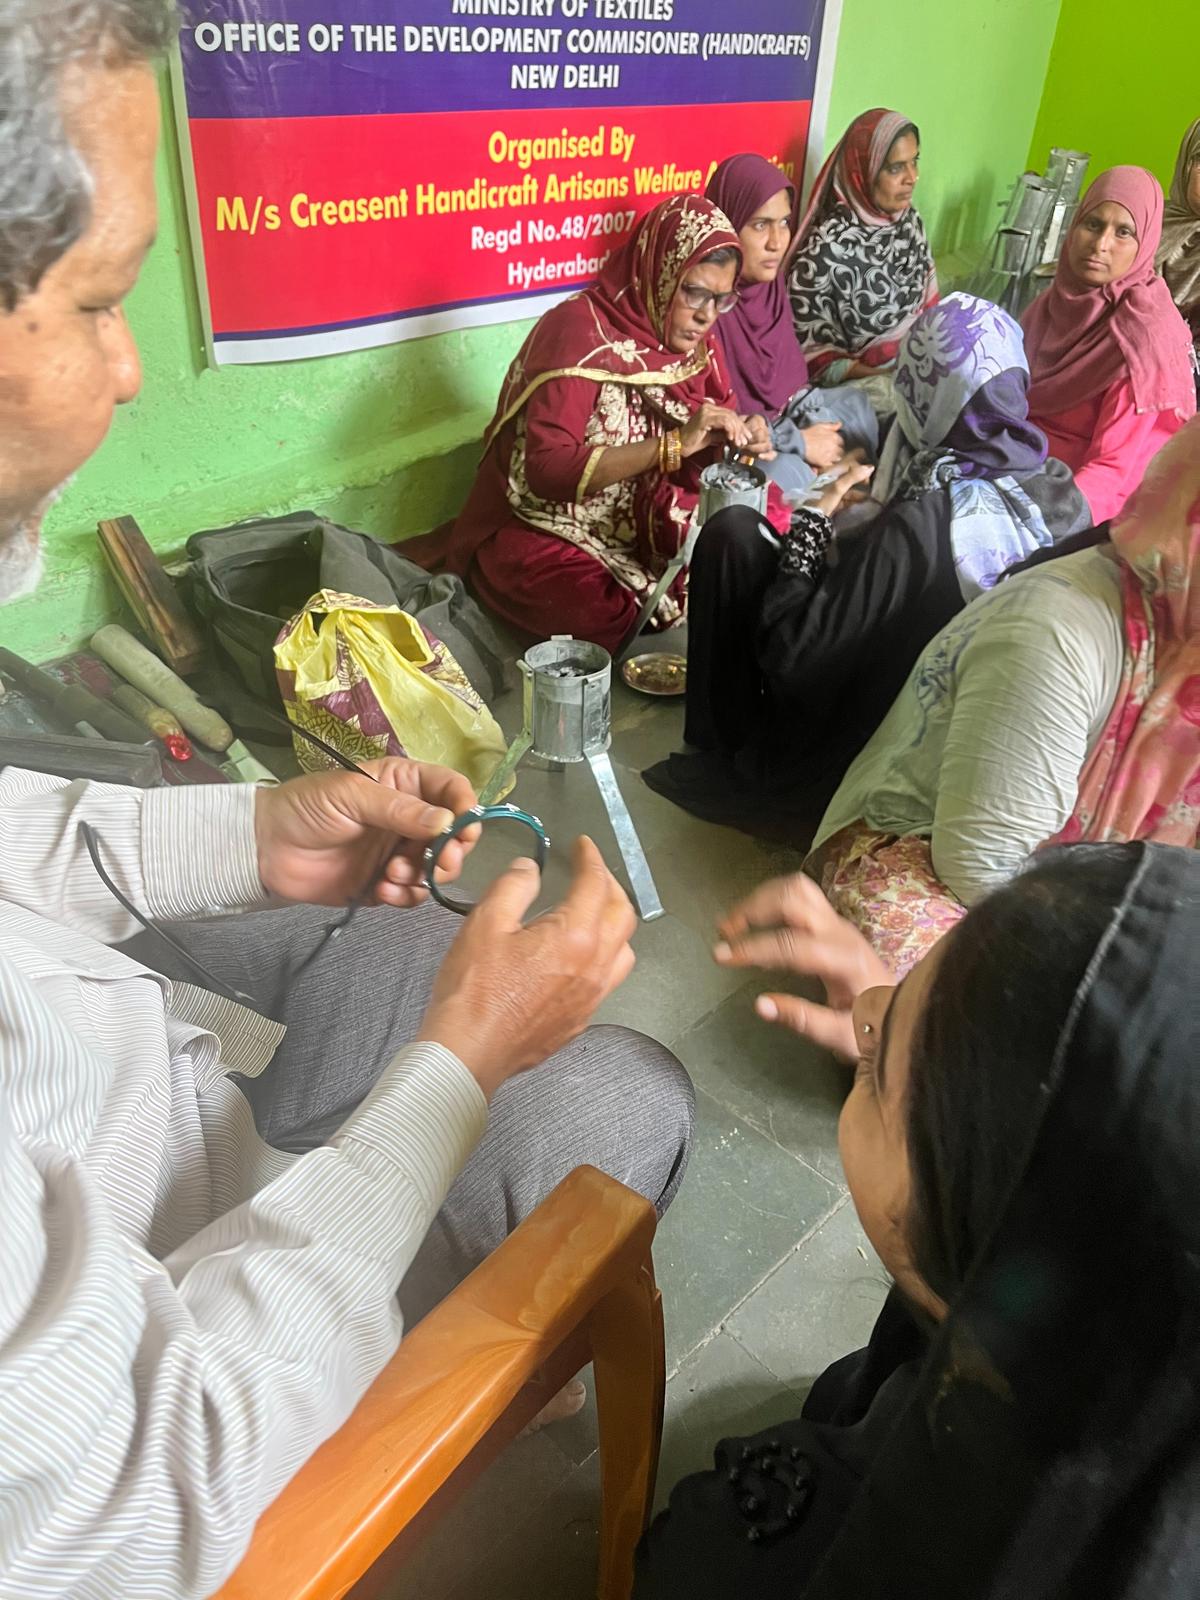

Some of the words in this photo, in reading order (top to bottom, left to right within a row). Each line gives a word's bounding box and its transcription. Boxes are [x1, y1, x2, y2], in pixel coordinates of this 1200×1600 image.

[452, 0, 554, 18] MINISTRY
[561, 0, 589, 19] OF
[596, 0, 675, 22] TEXTILES
[194, 22, 301, 53] OFFICE
[308, 23, 345, 53] OF
[350, 25, 398, 53] THE
[403, 26, 562, 54] DEVELOPMENT
[566, 29, 699, 55] COMMISIONER
[702, 32, 812, 61] (HANDICRAFTS)
[511, 65, 559, 90] NEW
[563, 65, 620, 89] DELHI
[488, 126, 605, 170] Organised
[610, 126, 636, 163] By
[215, 195, 282, 236] M/s
[289, 188, 409, 230] Creasent
[415, 173, 539, 216] Handicraft
[543, 172, 629, 204] Artisans
[633, 163, 702, 196] Welfare
[471, 225, 522, 254] Regd
[527, 210, 637, 245] No.48/2007
